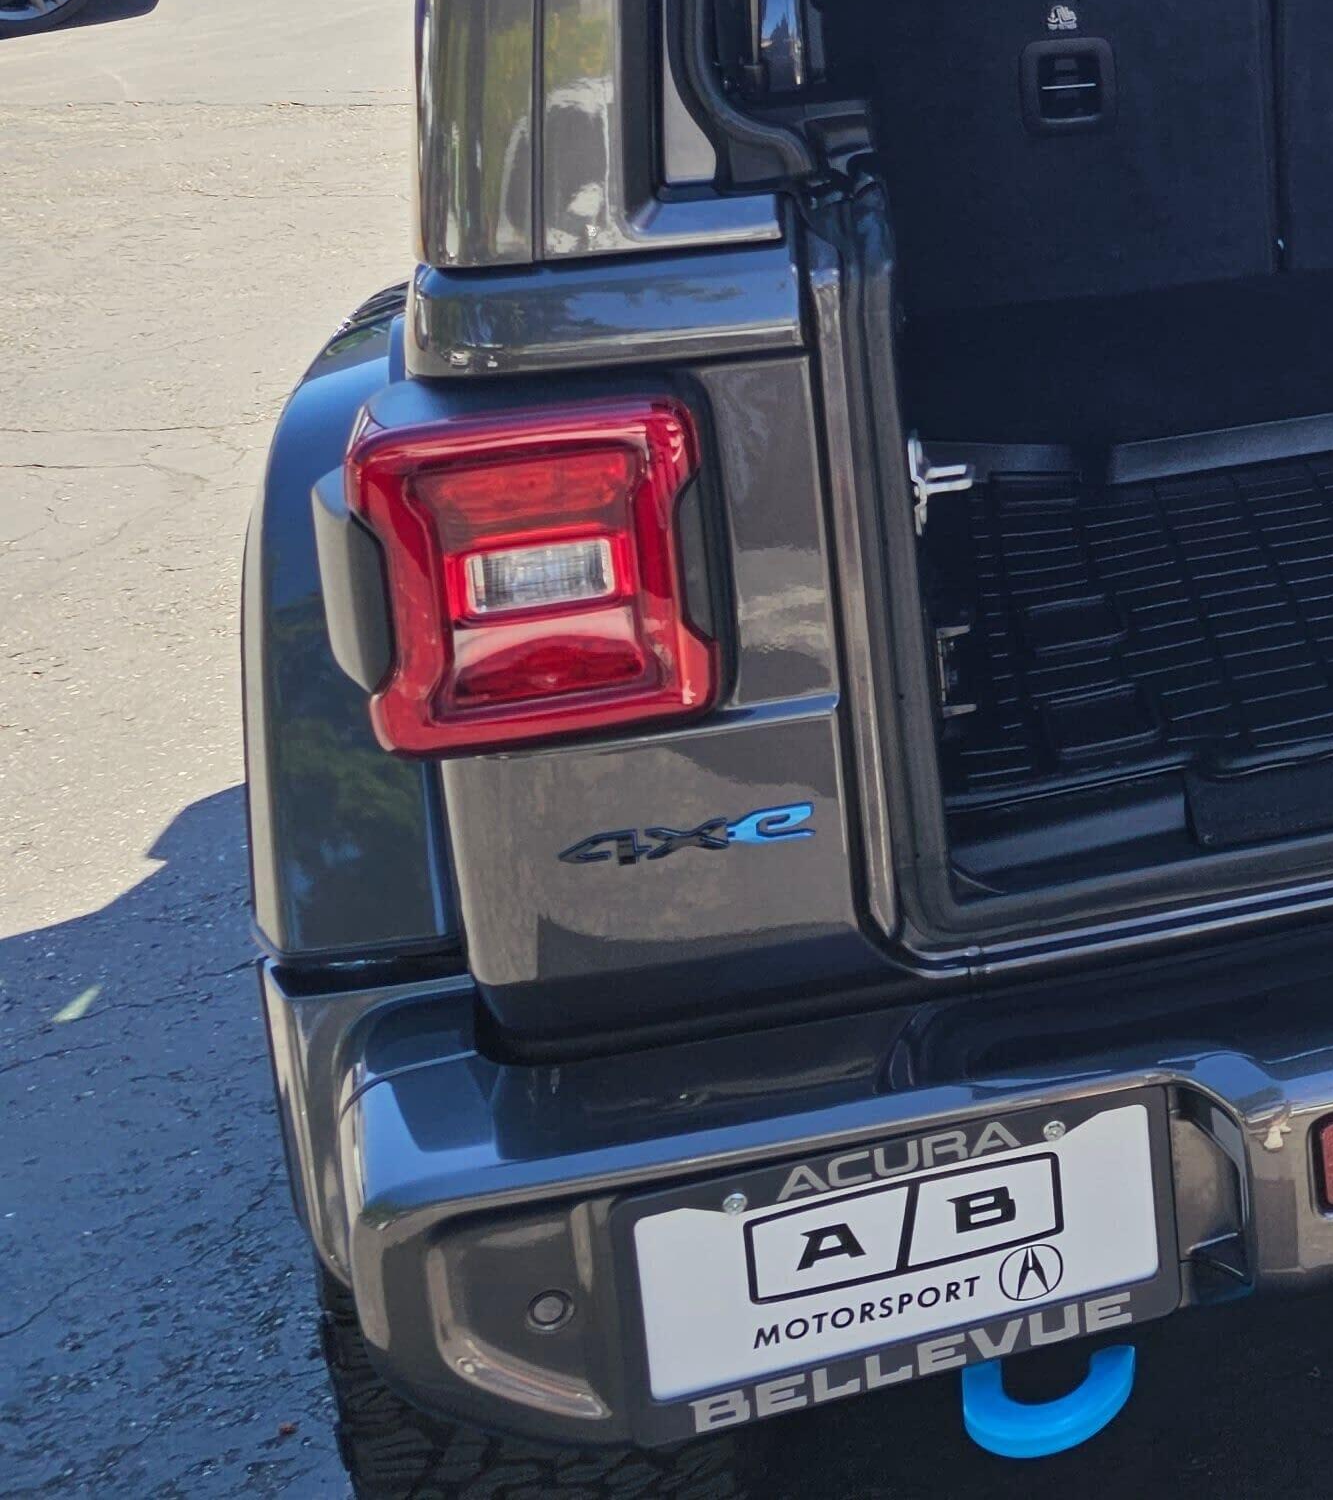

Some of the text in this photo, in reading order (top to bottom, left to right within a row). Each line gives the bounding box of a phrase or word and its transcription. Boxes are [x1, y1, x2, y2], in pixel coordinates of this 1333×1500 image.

[777, 1121, 1021, 1202] ACURA
[797, 1186, 1017, 1271] A B
[753, 1276, 981, 1349] MOTORSPORT
[689, 1291, 1133, 1434] BELLEVUE
